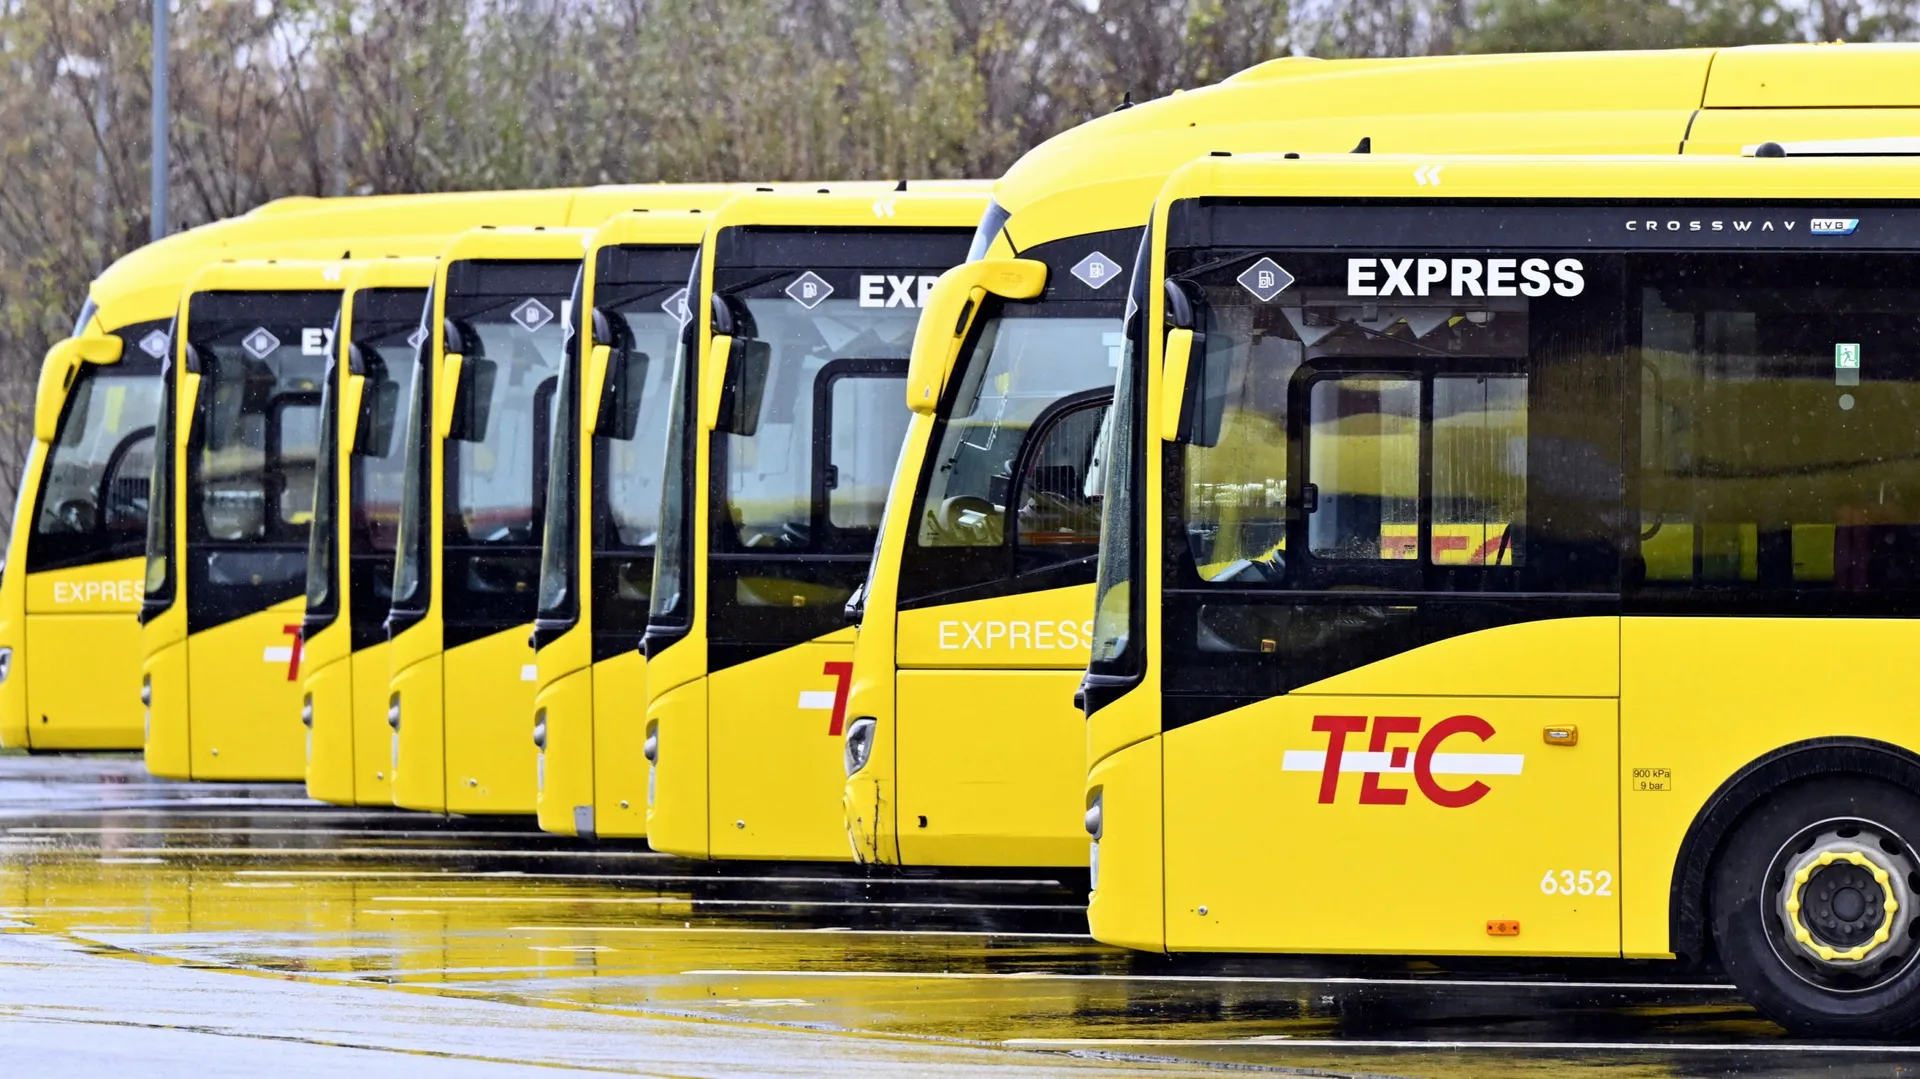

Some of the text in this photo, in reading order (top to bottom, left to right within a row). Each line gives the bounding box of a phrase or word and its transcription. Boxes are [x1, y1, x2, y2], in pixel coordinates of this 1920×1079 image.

[1347, 257, 1585, 298] EXPRESS
[53, 580, 146, 604] EXPRES
[1311, 714, 1497, 808] TEC
[1633, 769, 1670, 778] 900 kPa
[1640, 781, 1664, 790] 9 bar
[1540, 869, 1612, 896] 6352
